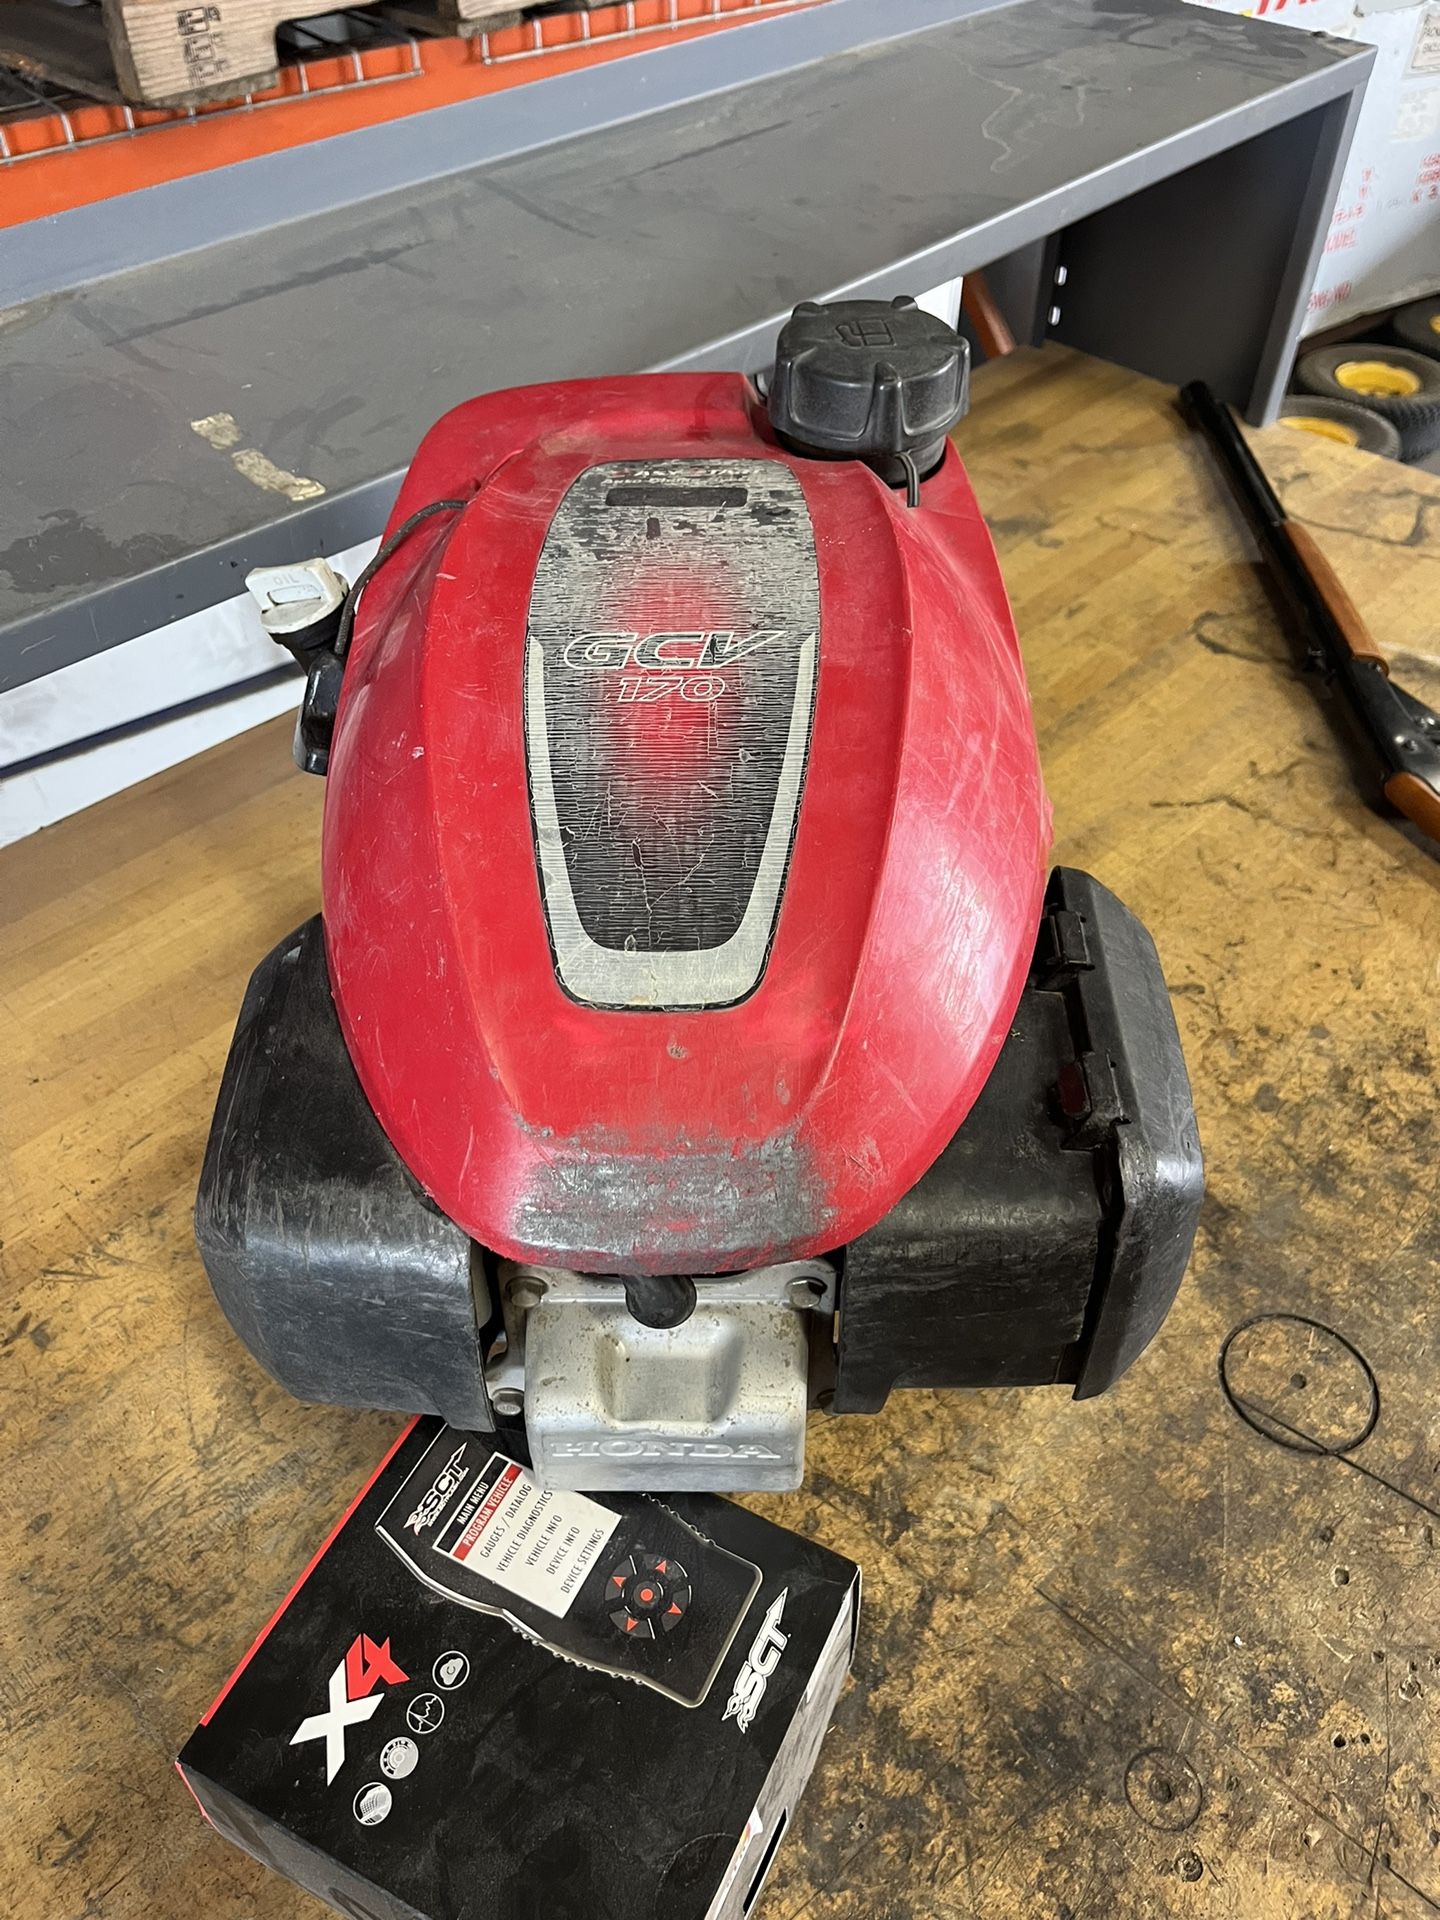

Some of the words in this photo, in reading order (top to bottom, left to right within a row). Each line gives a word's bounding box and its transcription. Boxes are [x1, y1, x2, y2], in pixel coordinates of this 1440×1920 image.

[273, 572, 300, 586] OIL
[563, 630, 787, 670] GCV
[617, 676, 726, 702] 170
[550, 1440, 782, 1459] HONDA
[411, 1442, 468, 1525] SCT
[456, 1503, 475, 1525] MAIN
[469, 1481, 489, 1505] MENU
[462, 1506, 494, 1547] PROGRAM
[488, 1476, 514, 1507] VEHICLE
[480, 1525, 505, 1558] GAUGES
[504, 1483, 532, 1518] DATALOG
[496, 1540, 522, 1572] VEHICLE
[516, 1490, 553, 1541] DIAGNOSTICS
[525, 1534, 551, 1566] VEHICLE
[545, 1514, 563, 1535] INFO
[546, 1546, 569, 1575] DEVICE
[563, 1526, 580, 1547] INFO
[560, 1564, 583, 1594] DEVICE
[577, 1528, 604, 1565] SETTINGS
[728, 1587, 788, 1717] SCT
[289, 1633, 411, 1787] X4
